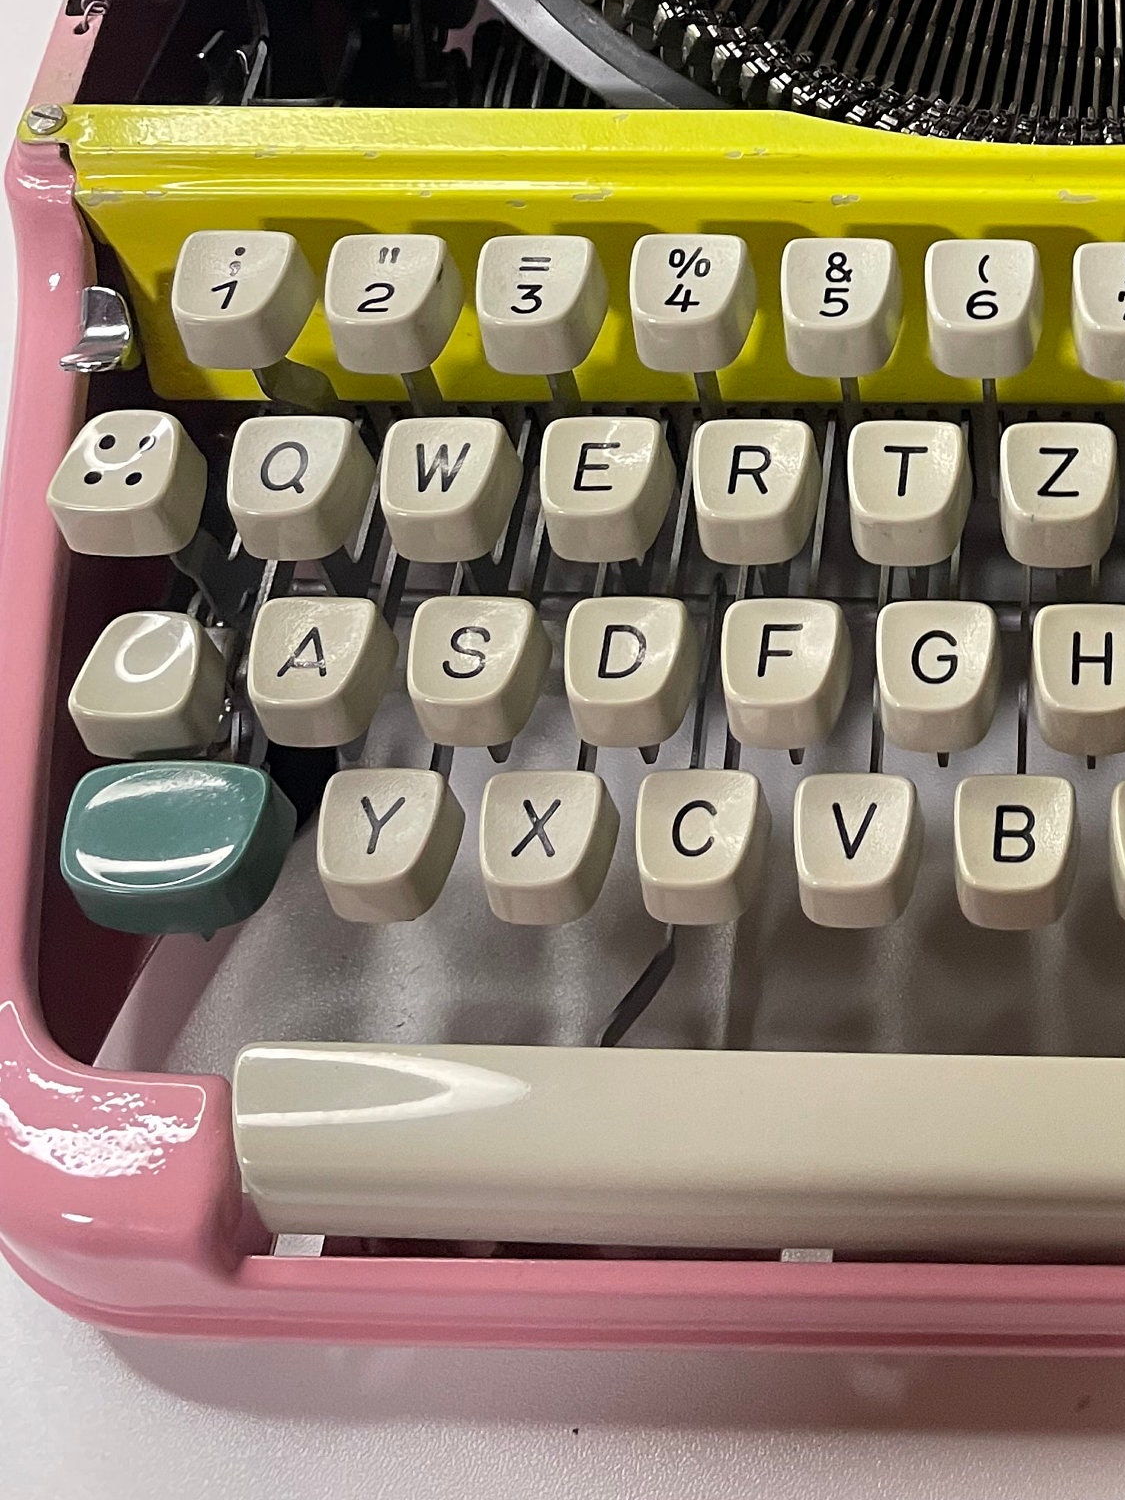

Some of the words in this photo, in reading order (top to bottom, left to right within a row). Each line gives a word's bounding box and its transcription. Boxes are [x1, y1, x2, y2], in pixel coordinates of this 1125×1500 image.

[668, 247, 711, 279] %
[825, 251, 853, 283] &
[211, 280, 239, 310] 1
[356, 282, 395, 313] 2
[510, 283, 543, 314] 3
[663, 283, 700, 313] 4
[818, 287, 850, 318] 5
[965, 289, 999, 320] 6
[260, 440, 309, 494] Q
[415, 442, 472, 493] W
[572, 441, 621, 492] E
[727, 444, 772, 496] R
[883, 445, 929, 497] T
[1036, 447, 1080, 498] Z
[276, 626, 328, 678] A
[441, 626, 491, 680] S
[598, 624, 647, 680] D
[757, 623, 804, 678] F
[910, 629, 958, 685] G
[1071, 630, 1113, 686] H
[359, 796, 406, 855] Y
[510, 799, 561, 858] X
[671, 799, 719, 858] C
[831, 801, 878, 860] V
[992, 804, 1036, 863] B
